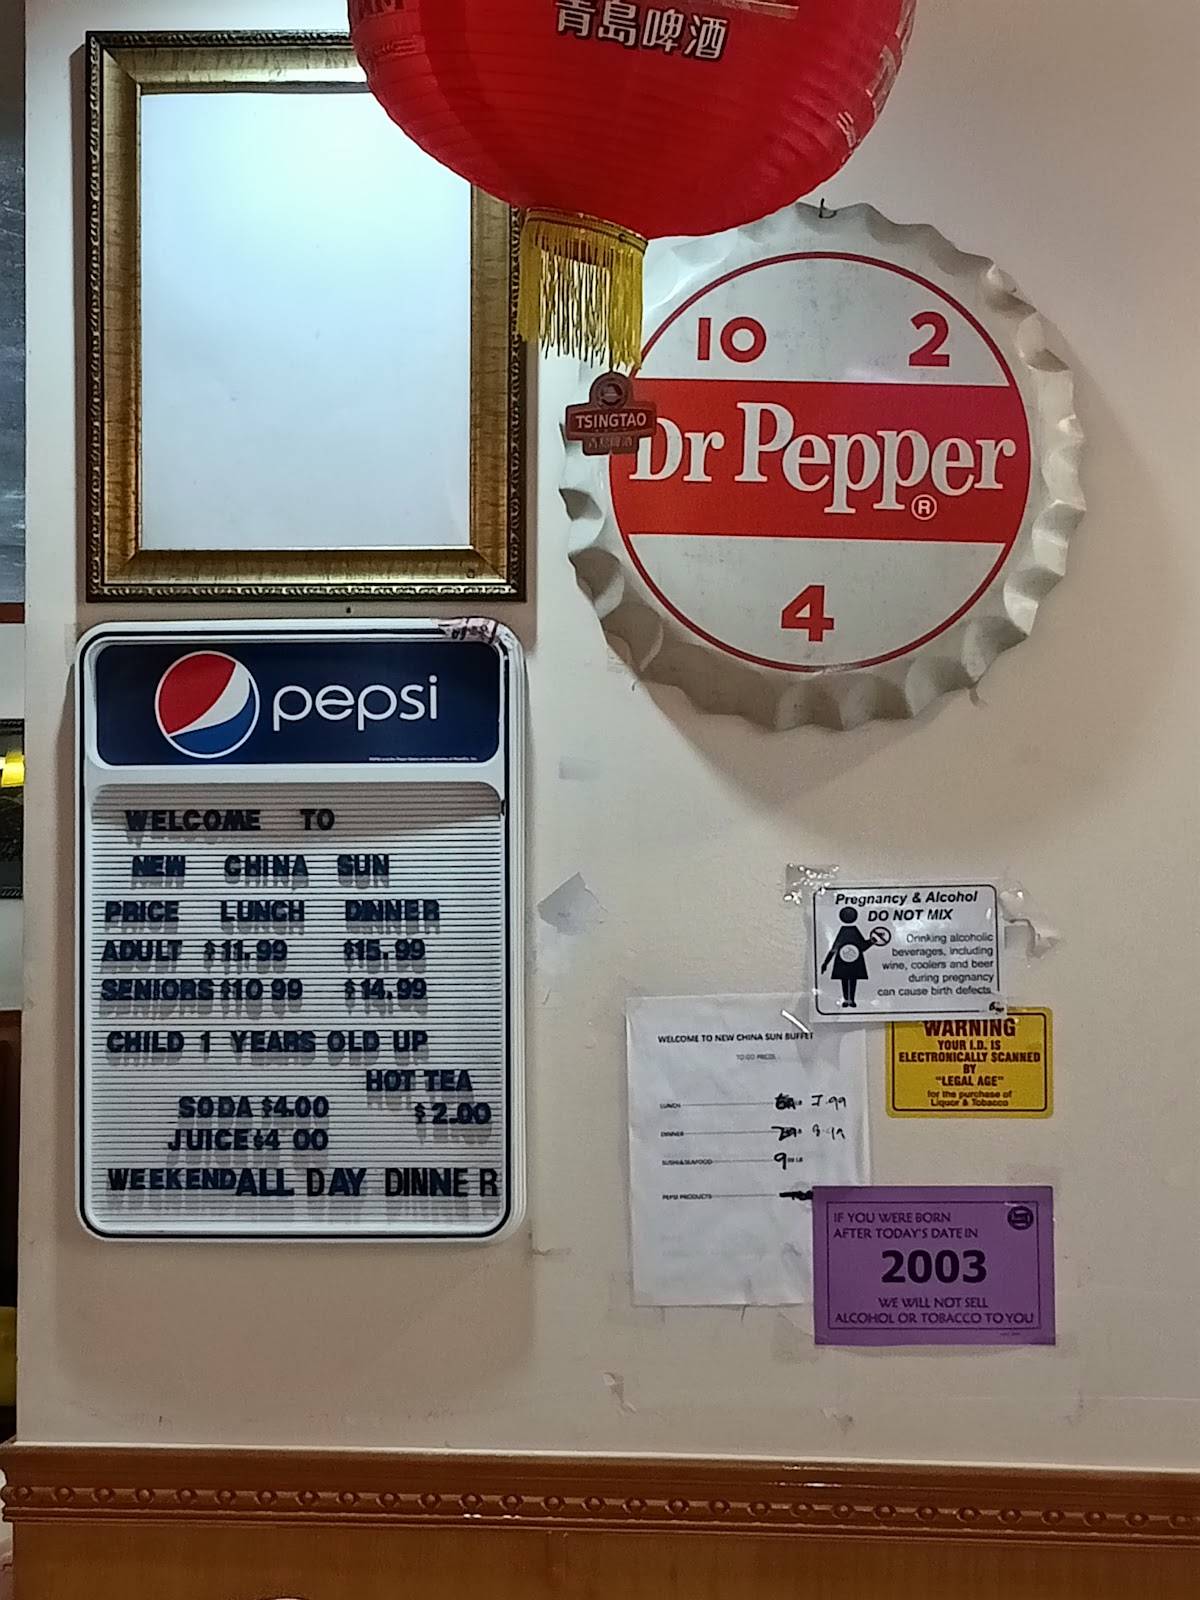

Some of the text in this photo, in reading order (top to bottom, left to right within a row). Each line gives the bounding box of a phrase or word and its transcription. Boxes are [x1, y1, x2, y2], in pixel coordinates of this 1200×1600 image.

[555, 0, 728, 59] 青島啤酒
[697, 317, 767, 362] 10
[909, 311, 950, 367] 2
[576, 412, 647, 429] TSINGTAO
[629, 401, 1017, 513] Dr Pepper
[780, 585, 834, 641] 4
[273, 675, 438, 731] pepsi
[124, 809, 335, 831] WELCOME TO
[132, 854, 390, 877] NEW CHINA SUN
[835, 891, 978, 907] Pregnancy & Alcohol
[104, 899, 440, 922] PRICE LUNCH DINNER
[868, 908, 954, 921] DO NOT MIX
[907, 933, 993, 944] Drinking alcoholic
[101, 939, 426, 961] ADULT $11.99 $15.99
[892, 946, 993, 958] beverages, including
[882, 959, 994, 970] wine, coolers and beer
[908, 973, 994, 984] during pregnancy
[101, 979, 214, 1000] SENIORS
[344, 978, 427, 1000] $14.99
[877, 988, 895, 996] can
[898, 987, 928, 996] cause
[930, 986, 952, 996] birth
[923, 1018, 1016, 1036] WARNING
[106, 1030, 429, 1053] CHILD 1 YEARS OLD UP
[658, 1032, 813, 1043] WELCOME TO NEW CHINA SUN BUFFET
[938, 1040, 1000, 1050] YOUR I.D. IS
[899, 1052, 1041, 1062] ELECTRONICALLY SCANNED
[963, 1064, 976, 1074] BY
[366, 1069, 473, 1092] HOT TEA
[931, 1099, 959, 1108] Liquor
[972, 1099, 1009, 1107] Tobacco
[959, 1091, 1000, 1100] purchase
[178, 1095, 491, 1124] SODA $4.00 $2.00
[168, 1129, 250, 1151] JUICE
[235, 1168, 294, 1196] ALL
[306, 1168, 367, 1196] DAY
[834, 1212, 951, 1223] IF YOU WERE BORN
[834, 1228, 978, 1239] AFTER TODAY'S DATE IN
[881, 1250, 987, 1283] 2003
[878, 1297, 988, 1309] WE WILL NOT SELL
[835, 1312, 1033, 1324] ALCOHOL OR TOBACCO TO YOU
